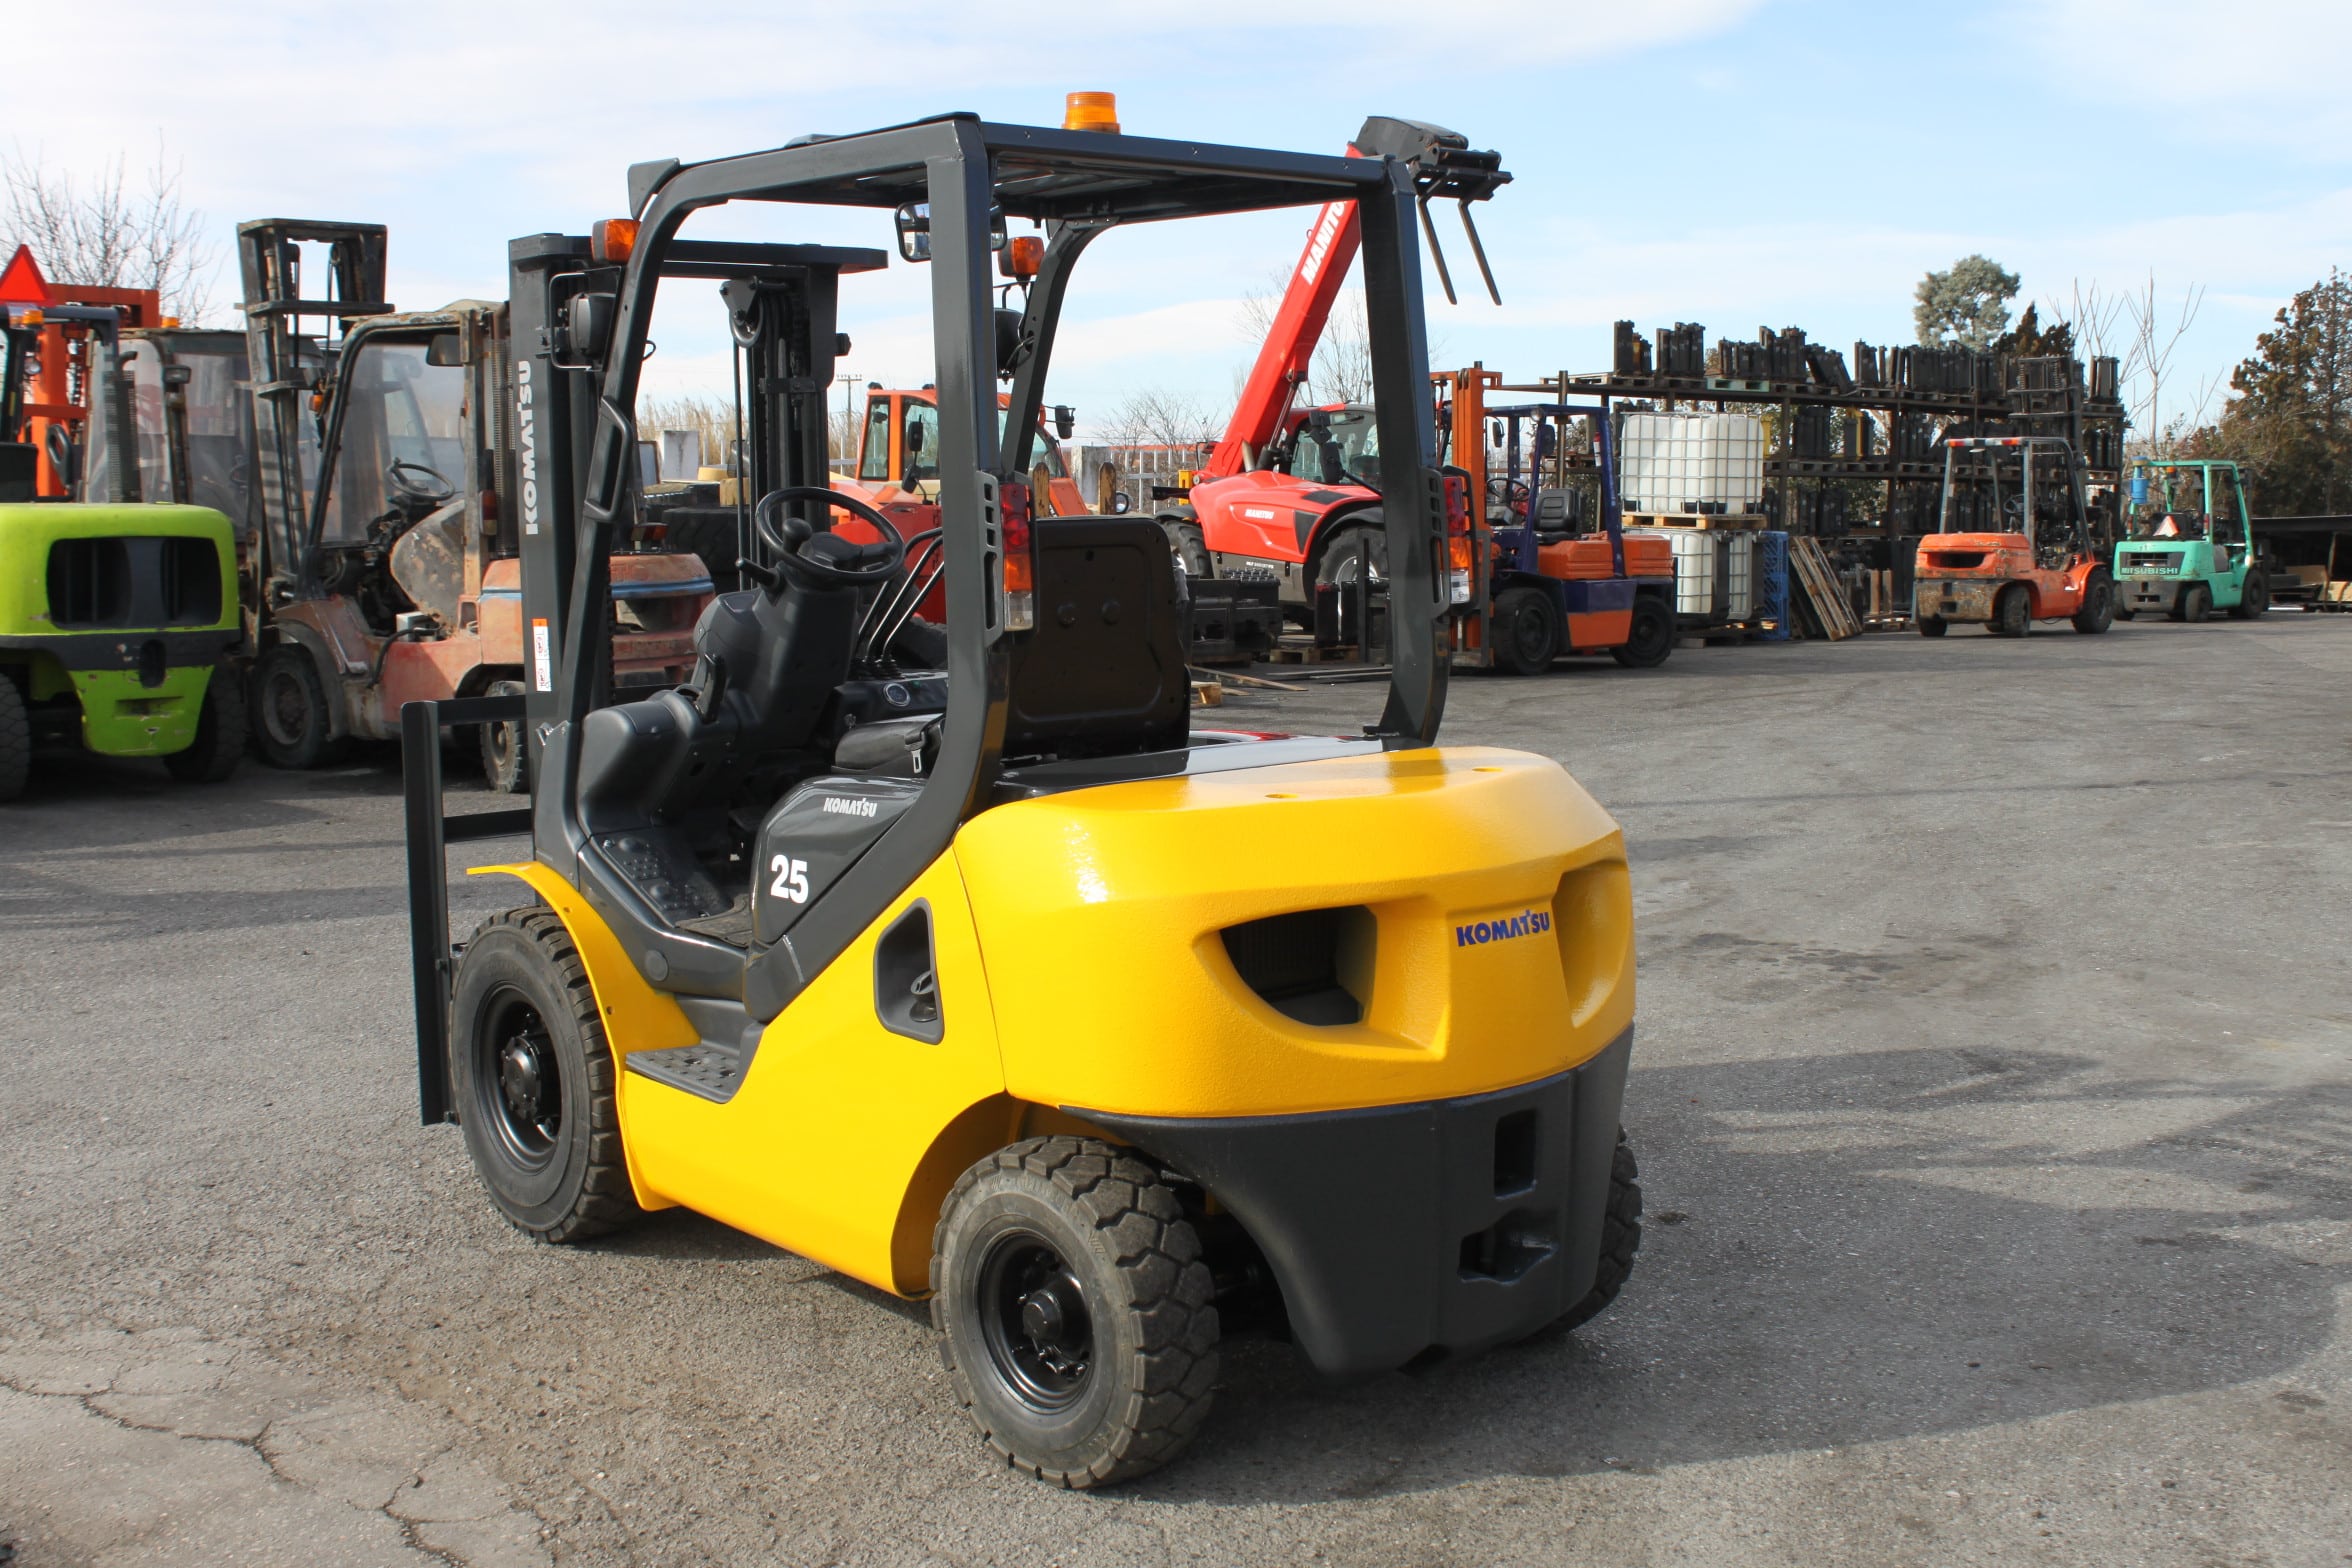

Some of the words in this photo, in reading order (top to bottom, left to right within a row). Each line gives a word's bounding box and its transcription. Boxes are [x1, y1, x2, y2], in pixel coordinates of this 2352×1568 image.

[517, 360, 539, 535] KOMATSU
[823, 797, 878, 817] KOMATSU
[770, 854, 809, 903] 25
[1456, 909, 1550, 947] KOMATSU
